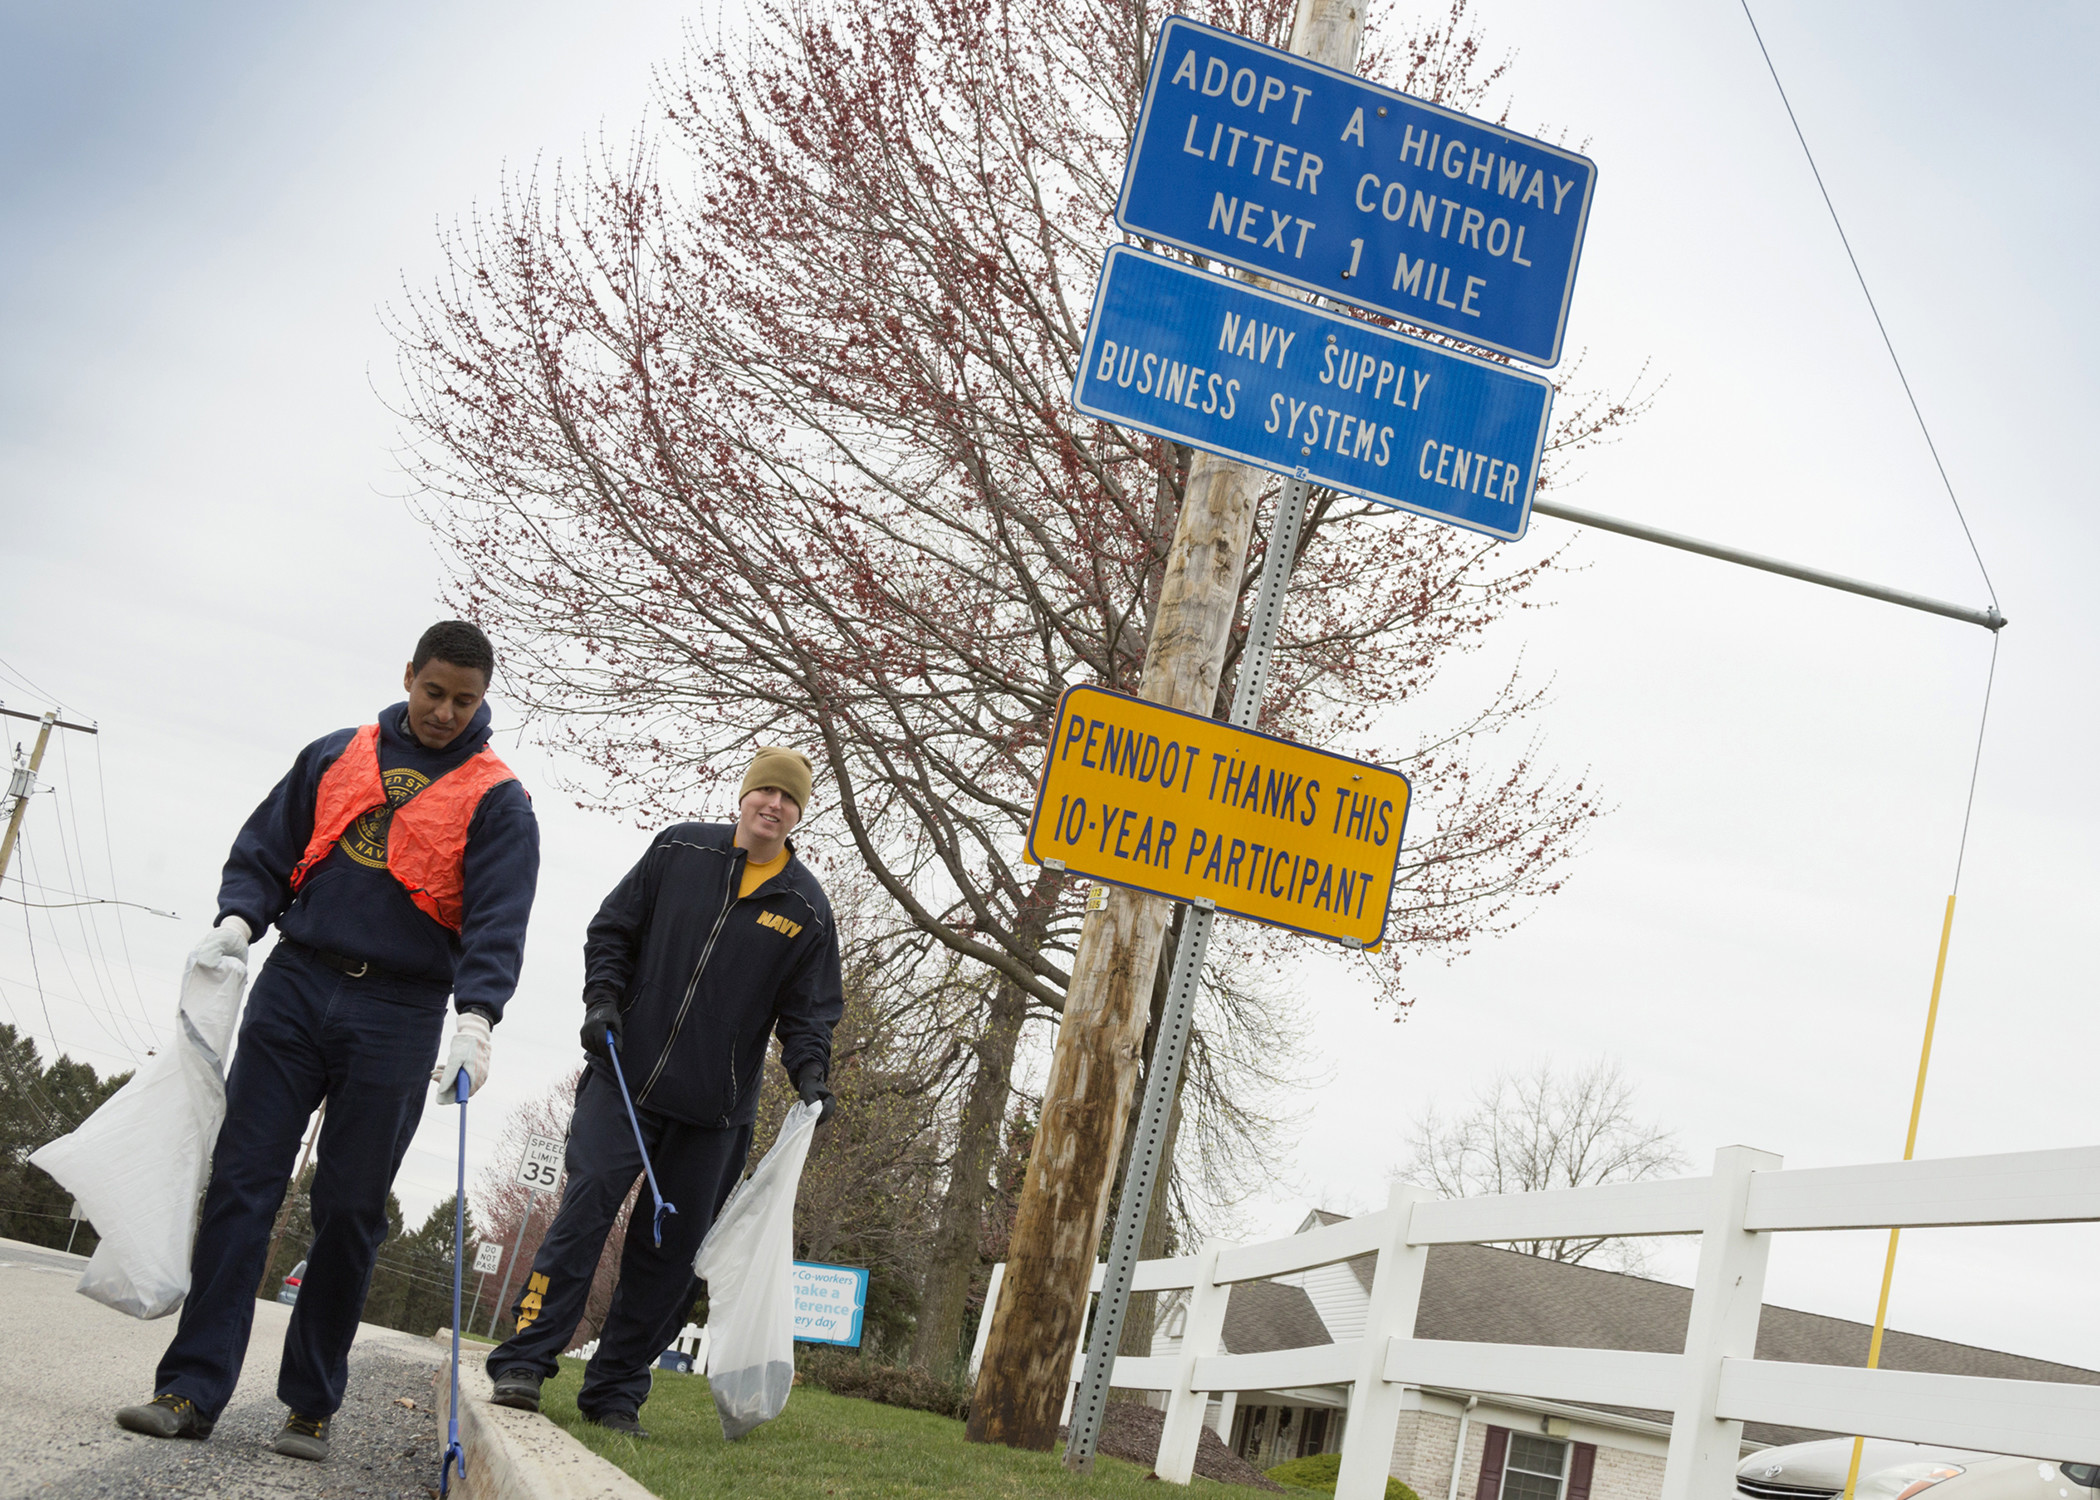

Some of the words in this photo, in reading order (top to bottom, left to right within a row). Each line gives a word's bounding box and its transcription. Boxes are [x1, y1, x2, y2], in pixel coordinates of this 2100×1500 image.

[1171, 49, 1312, 125] ADOPT
[1340, 106, 1366, 147] A
[1399, 124, 1575, 216] HIGHWAY
[1183, 114, 1325, 195] LITTER
[1356, 173, 1532, 267] CONTROL
[1208, 192, 1316, 260] NEXT
[1349, 237, 1364, 277] 1
[1392, 253, 1488, 318] MILE
[1218, 311, 1296, 370] NAVY
[1319, 343, 1431, 411] SUPPLY
[1096, 340, 1240, 420] BUSINESS
[1265, 393, 1395, 468] SYSTEMS
[1419, 439, 1521, 506] CENTER
[1062, 714, 1200, 793] PENNDOT
[1208, 753, 1320, 827] THANKS
[1333, 787, 1393, 847] THIS
[355, 841, 385, 858] NAV
[1054, 794, 1177, 870] 10-YEAR
[1184, 828, 1374, 920] PARTICIPANT
[756, 910, 803, 938] NAVY
[531, 1138, 564, 1155] SPEED
[531, 1150, 559, 1165] LIMIT
[523, 1162, 556, 1185] 35
[481, 1253, 496, 1262] NOT
[485, 1245, 496, 1254] DO
[476, 1260, 496, 1271] PASS
[798, 1270, 853, 1285] Co-workers
[831, 1288, 840, 1299] a
[794, 1297, 849, 1316] ference
[794, 1315, 813, 1328] ery
[815, 1316, 837, 1330] day
